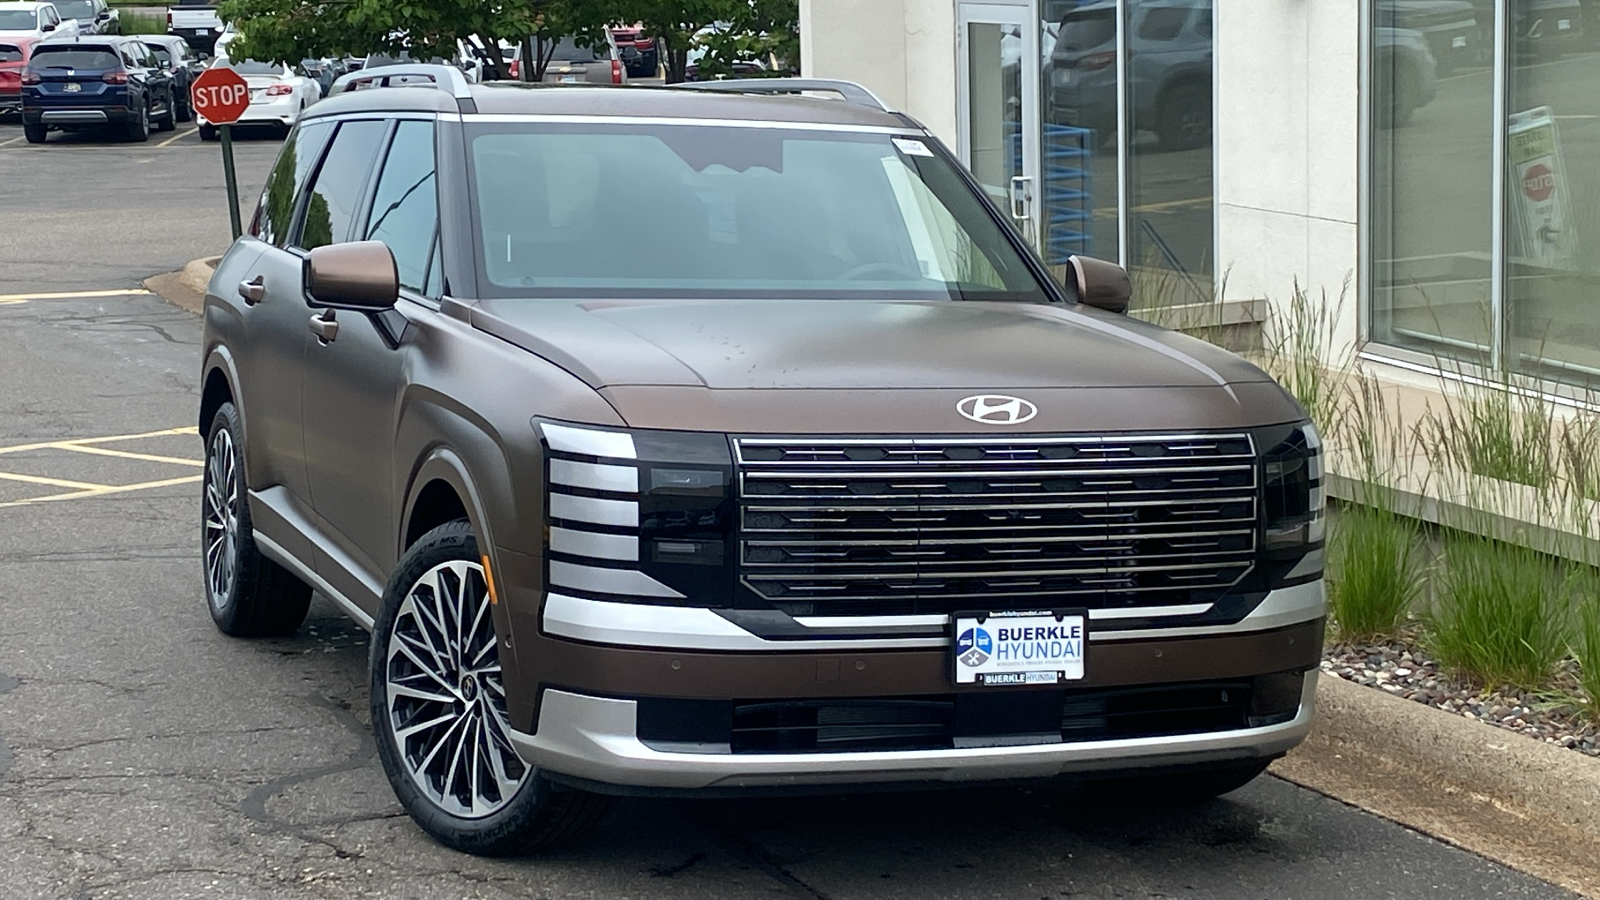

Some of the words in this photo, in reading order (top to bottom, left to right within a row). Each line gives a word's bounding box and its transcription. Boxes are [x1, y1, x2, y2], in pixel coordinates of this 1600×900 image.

[196, 83, 246, 108] STOP
[998, 625, 1081, 642] BUERKLE
[997, 640, 1081, 660] HYUNDAI
[985, 673, 1026, 684] BUERKLE
[1026, 672, 1056, 682] HYUNDAI
